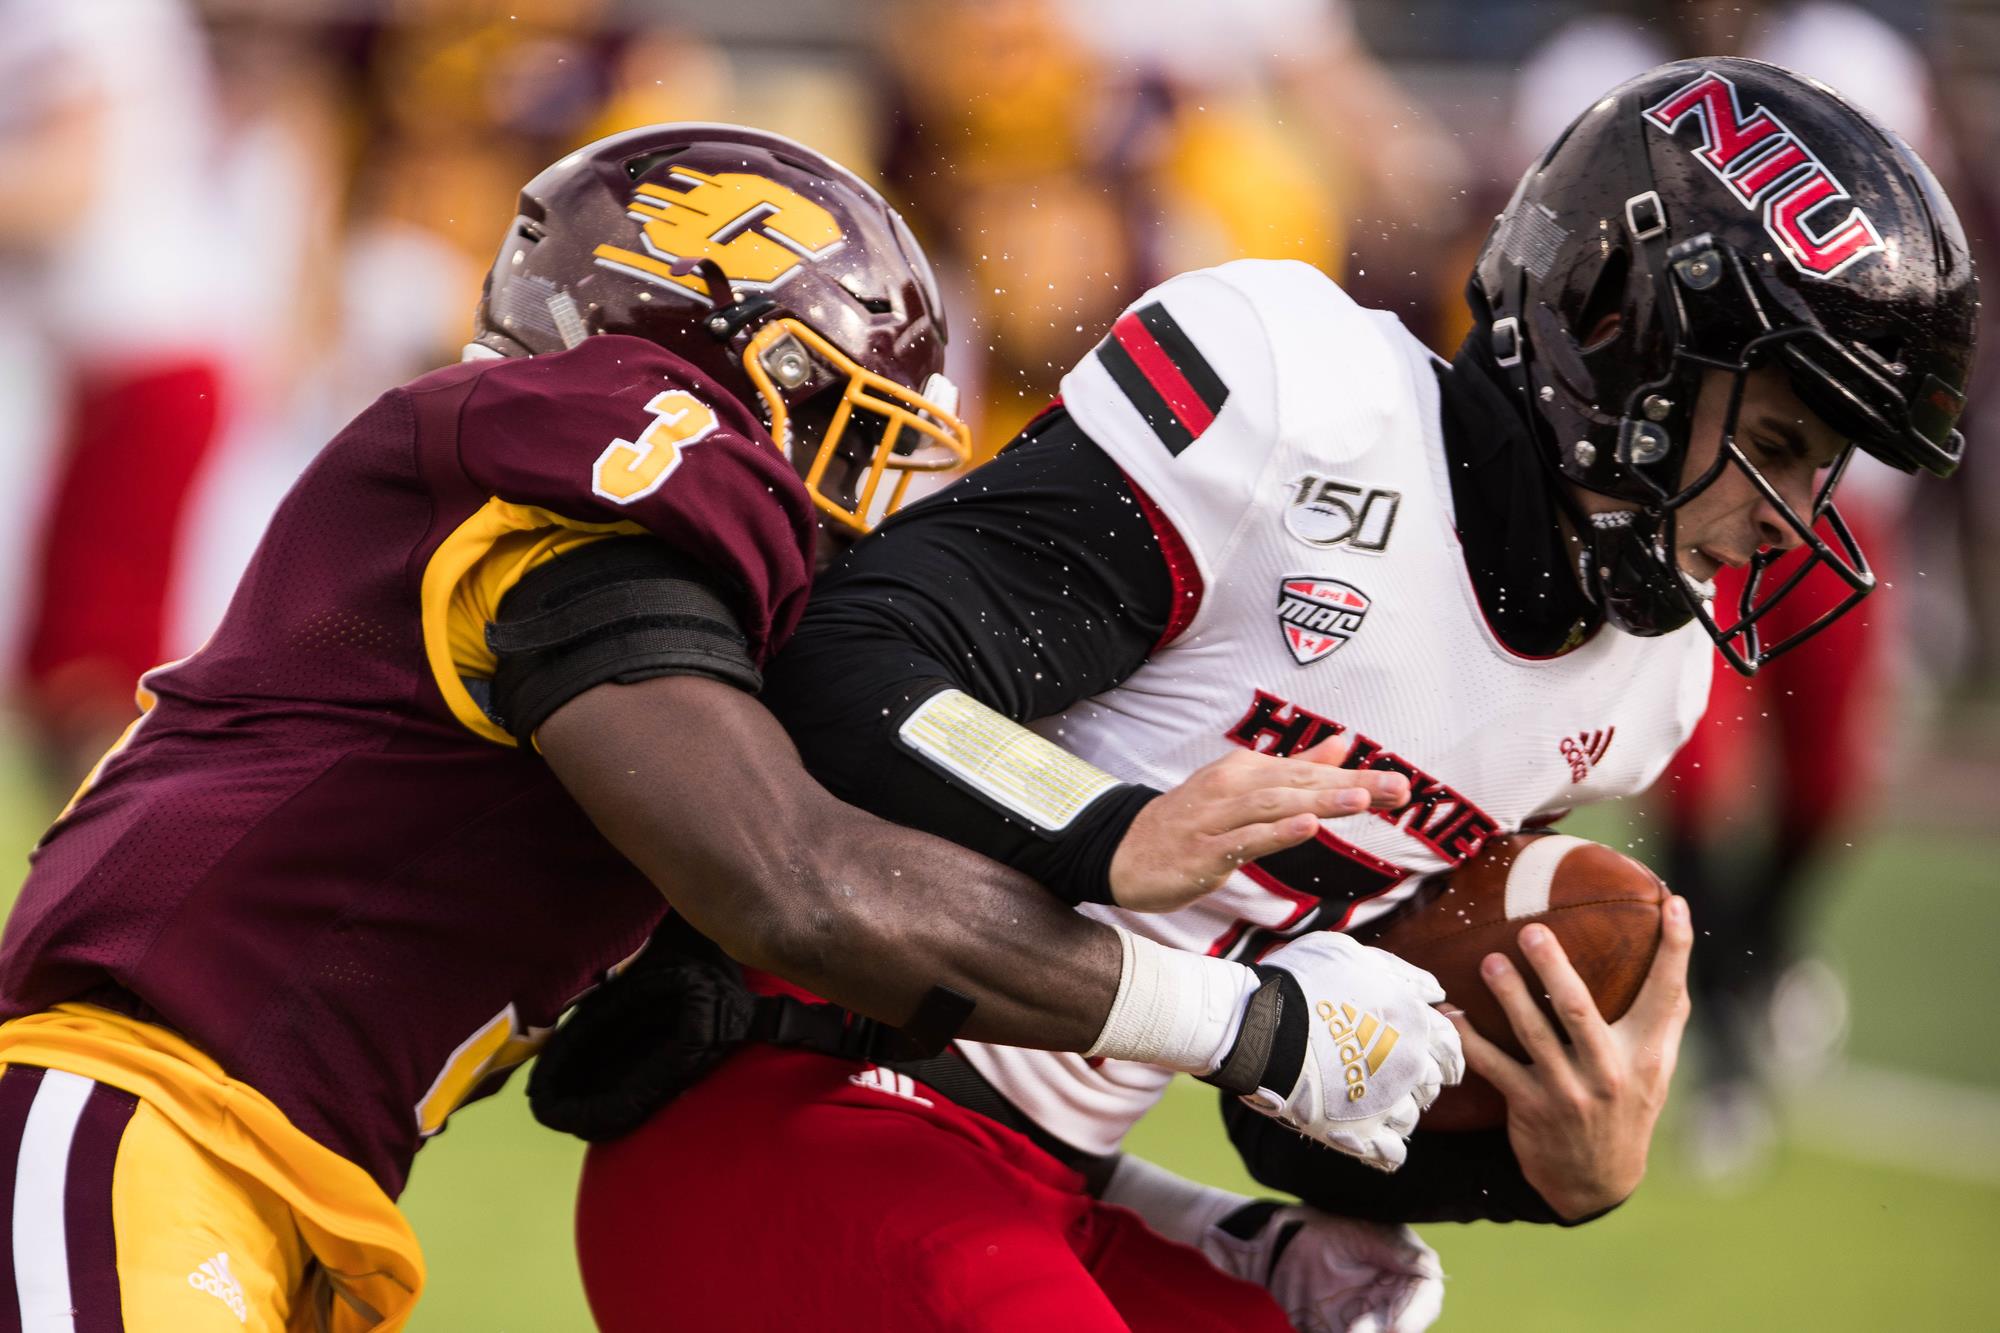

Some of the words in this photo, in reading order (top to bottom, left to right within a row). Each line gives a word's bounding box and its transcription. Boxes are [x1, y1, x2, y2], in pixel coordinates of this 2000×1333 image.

[1643, 71, 1885, 280] NIU
[592, 389, 720, 505] 3
[1286, 475, 1401, 554] 150
[1275, 595, 1362, 638] MAC
[1316, 999, 1367, 1103] adidas
[187, 1272, 247, 1323] adida
